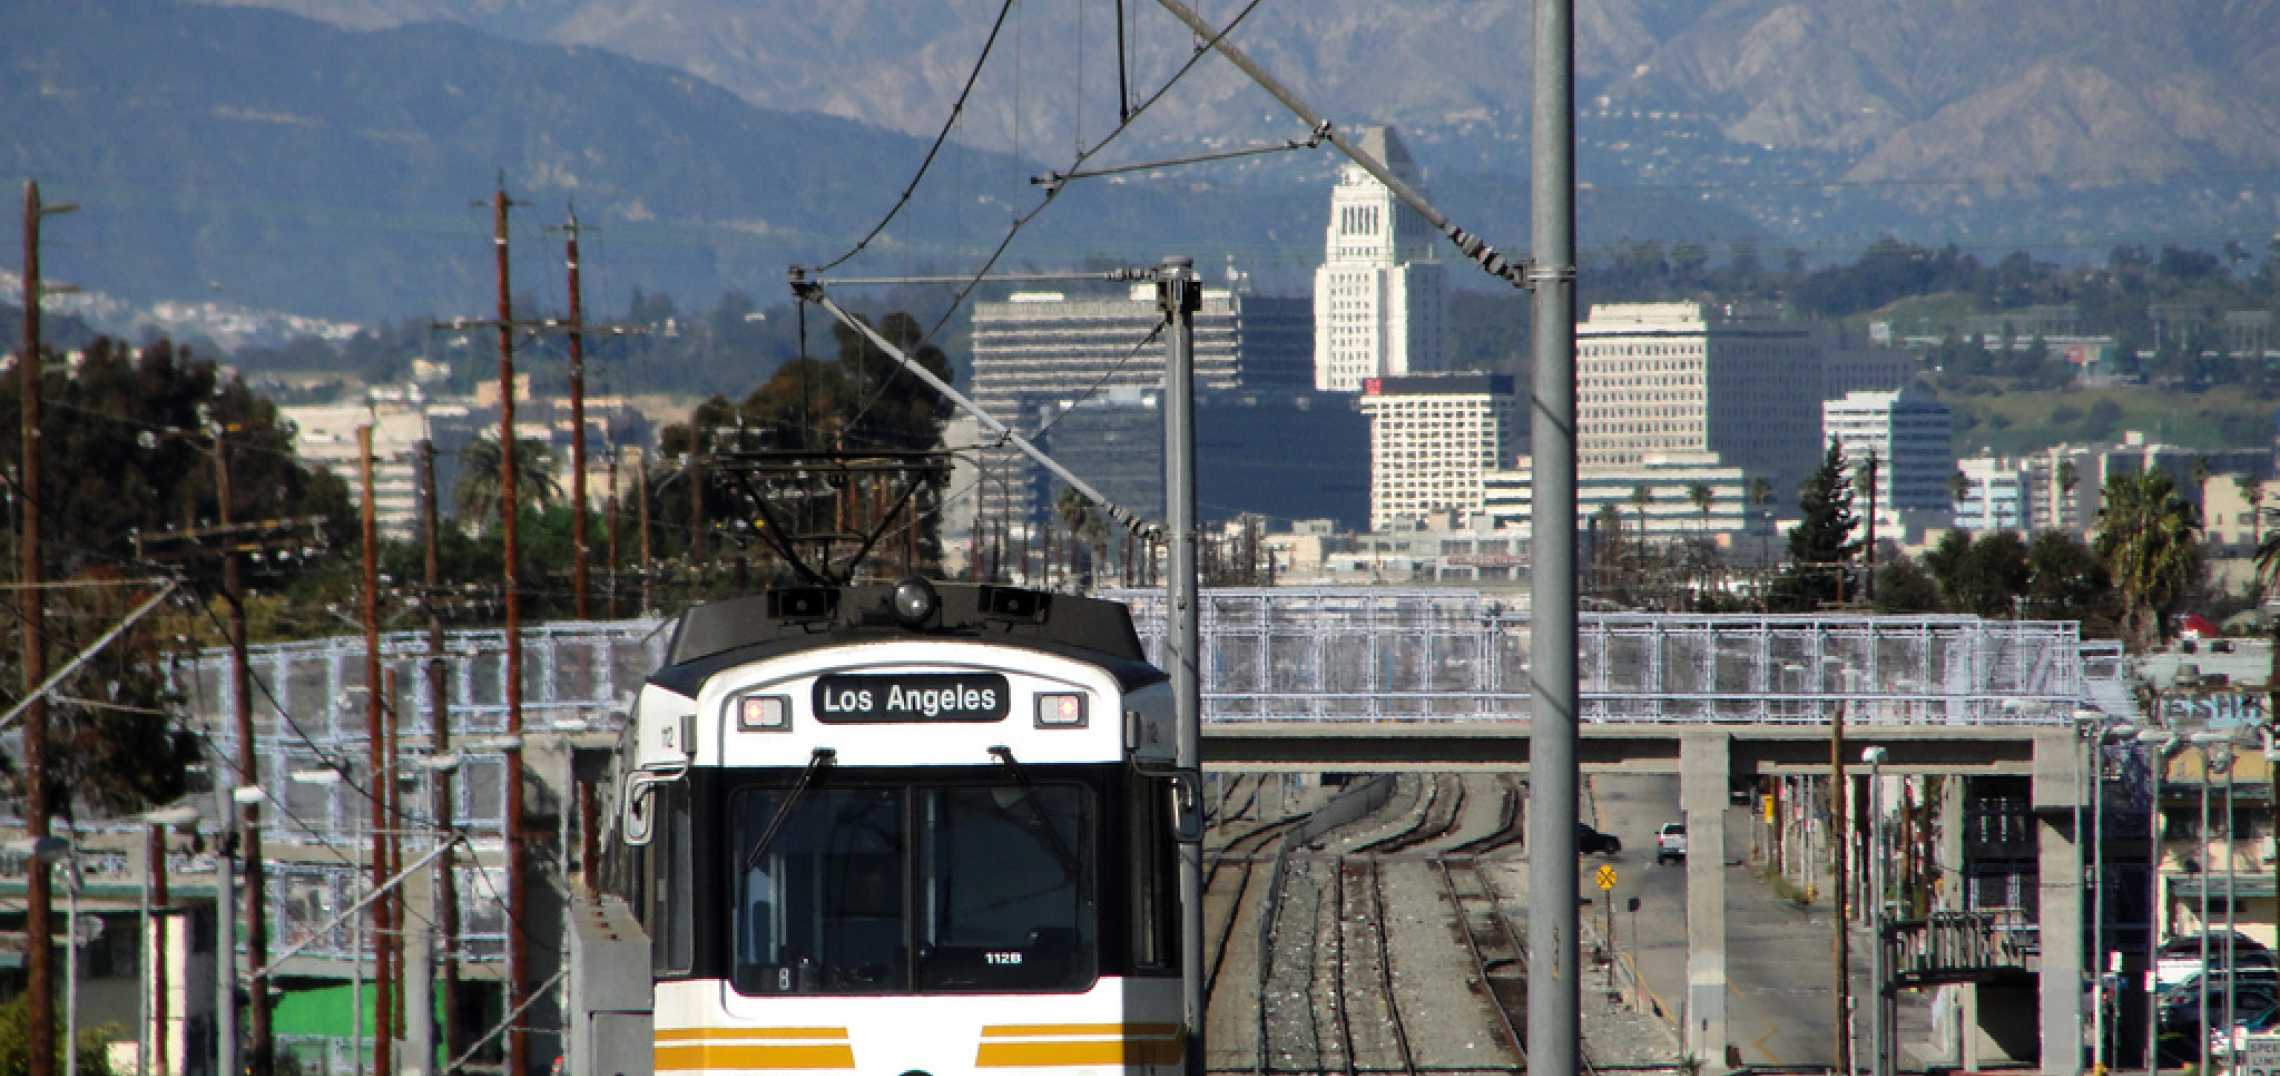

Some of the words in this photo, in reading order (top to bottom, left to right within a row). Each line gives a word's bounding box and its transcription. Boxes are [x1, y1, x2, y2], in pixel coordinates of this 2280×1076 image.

[824, 685, 873, 712] Los
[886, 683, 996, 716] Angeles
[984, 951, 1023, 965] 112B
